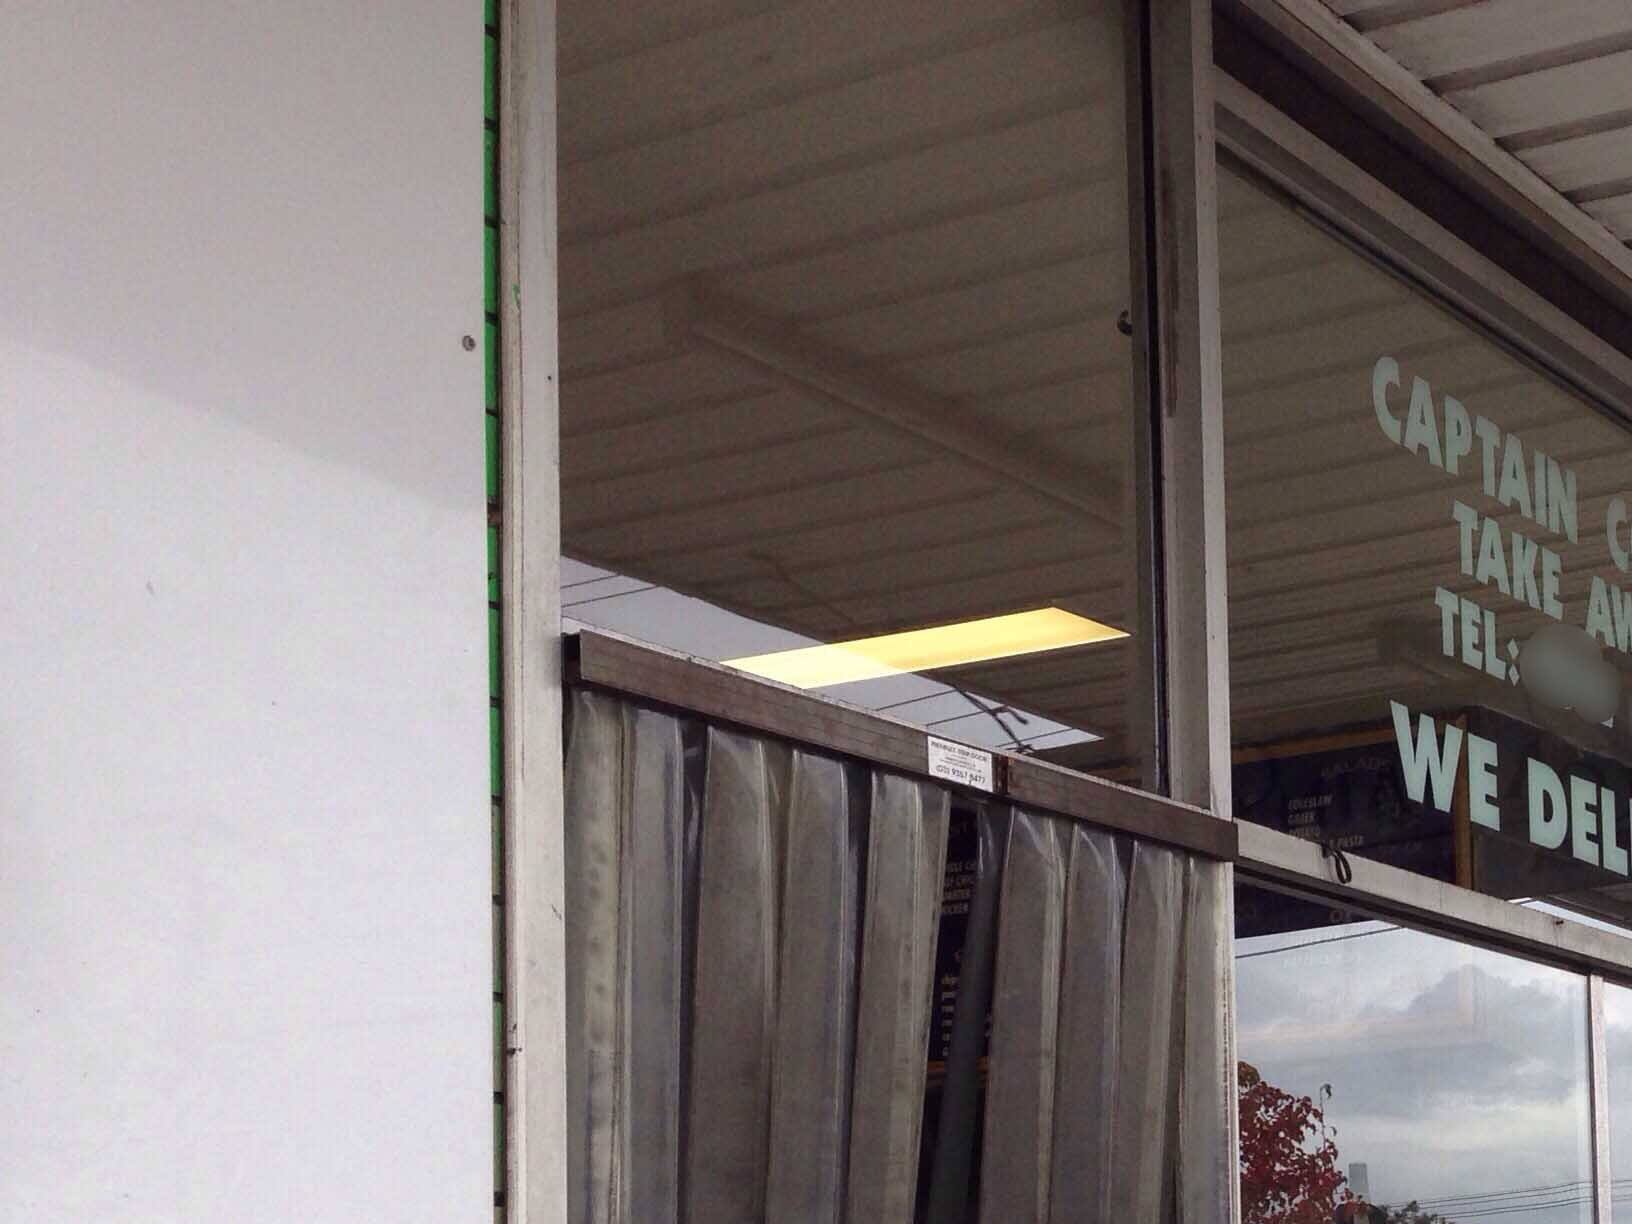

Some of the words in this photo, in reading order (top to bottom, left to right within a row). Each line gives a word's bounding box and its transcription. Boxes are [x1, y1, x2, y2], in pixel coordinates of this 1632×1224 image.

[1372, 356, 1578, 544] CAPTAIN
[1453, 500, 1562, 620] TAKE
[1434, 585, 1520, 686] TEL:
[1390, 699, 1500, 832] WE
